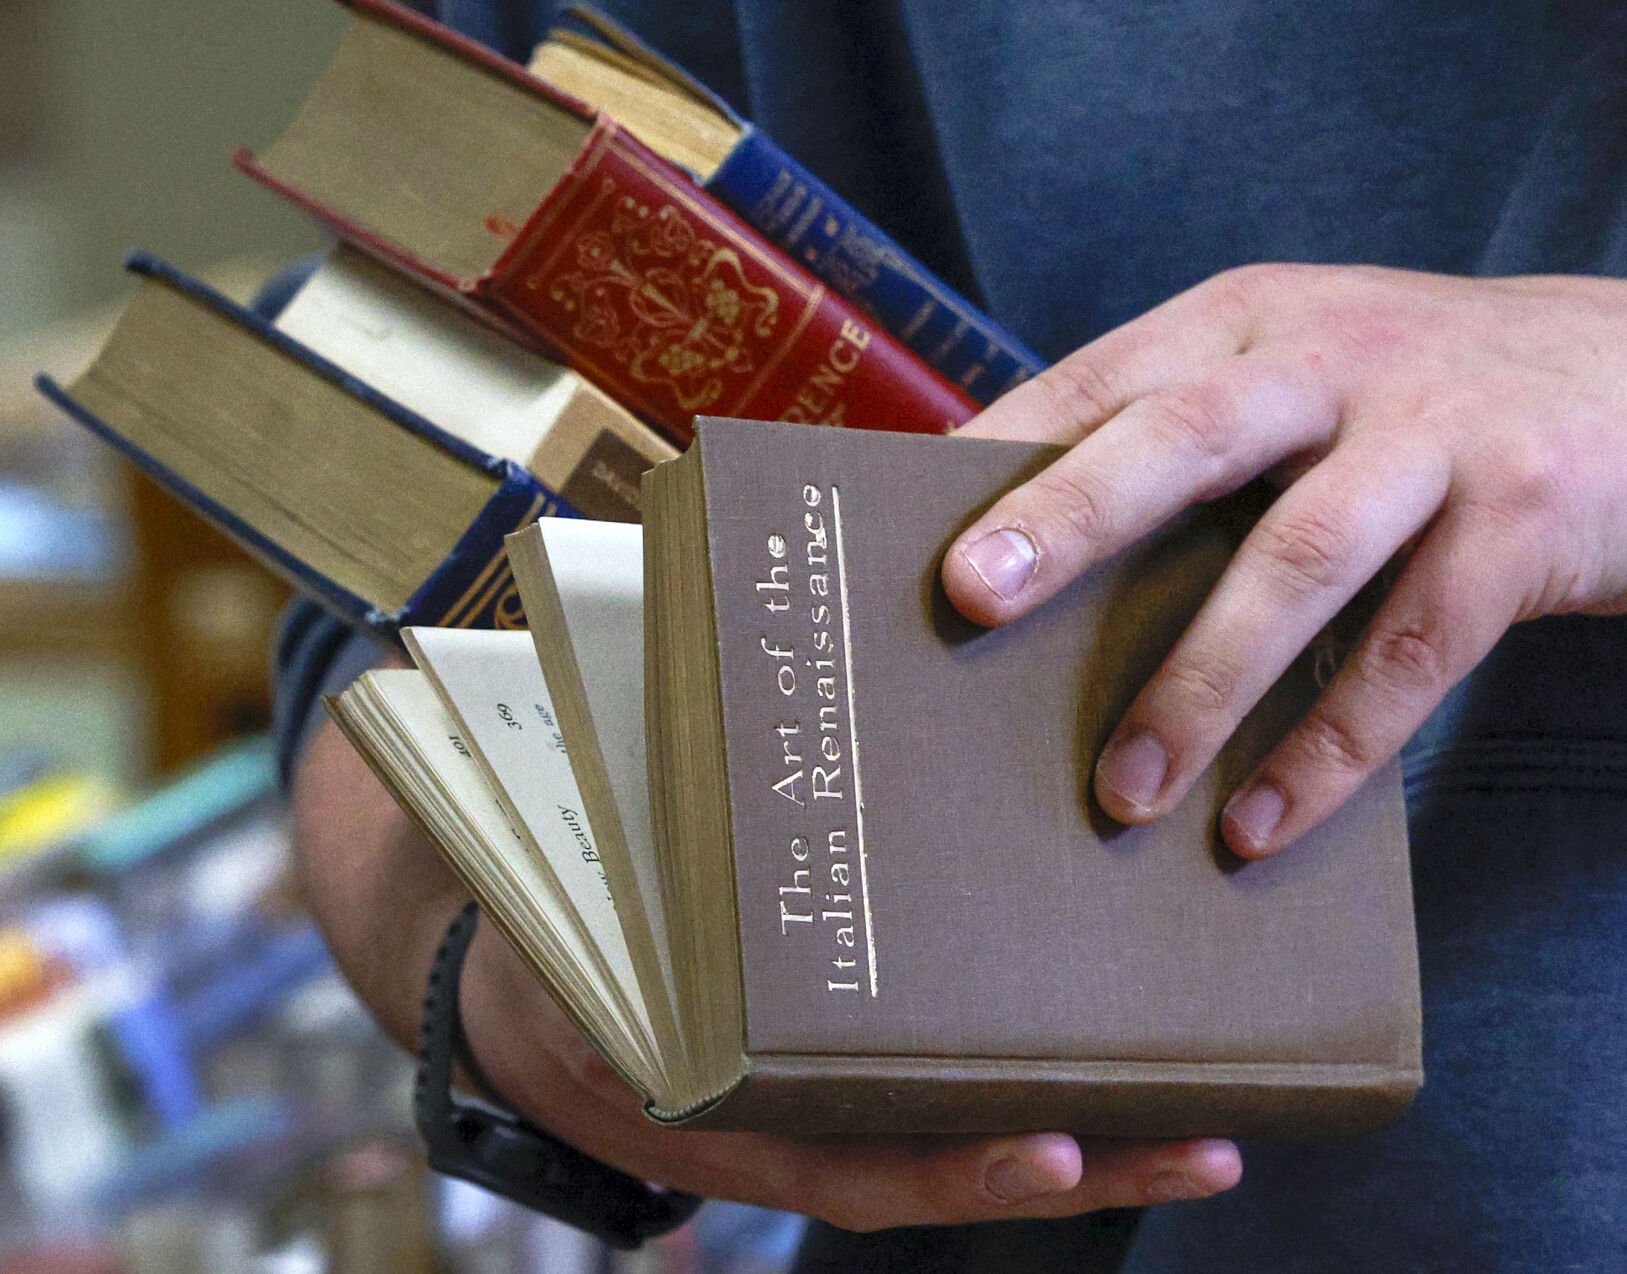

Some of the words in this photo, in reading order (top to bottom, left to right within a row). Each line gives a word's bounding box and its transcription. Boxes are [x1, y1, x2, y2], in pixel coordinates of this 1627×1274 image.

[756, 534, 791, 613] the
[761, 638, 795, 696] of
[803, 484, 843, 800] Renaissance
[497, 703, 522, 730] 369
[771, 719, 805, 806] Art
[557, 804, 601, 864] Beauty
[778, 836, 813, 936] The
[822, 829, 859, 992] Italian
